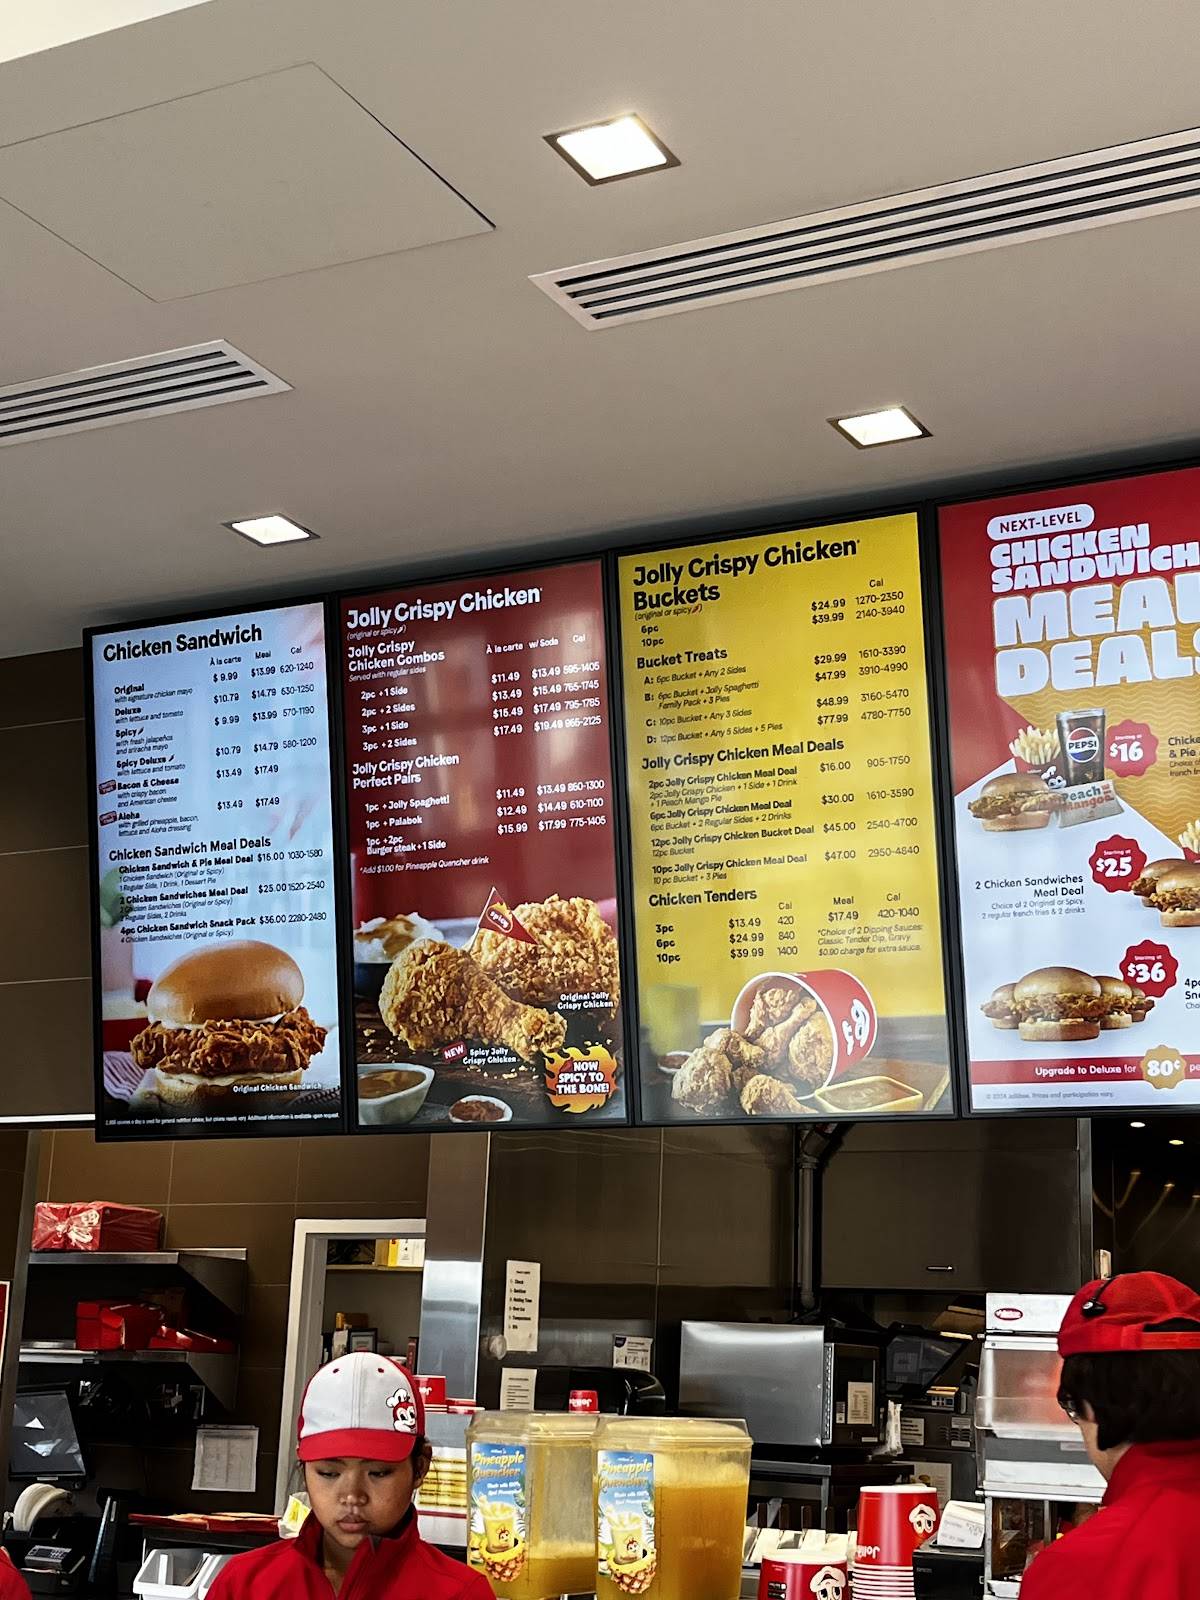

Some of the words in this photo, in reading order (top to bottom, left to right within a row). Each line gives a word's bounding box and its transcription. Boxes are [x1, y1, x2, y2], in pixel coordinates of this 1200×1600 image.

[1000, 511, 1081, 534] NEXT-LEVEL
[990, 523, 1150, 568] CHICKEN
[633, 564, 684, 587] Jolly
[688, 554, 758, 577] Crispy
[991, 542, 1200, 593] SANDWICH
[869, 579, 883, 588] Cal
[633, 584, 720, 611] Buckets
[811, 598, 846, 612] $24.99
[855, 591, 904, 605] 1270-2350
[346, 608, 391, 629] Jolly
[395, 599, 457, 622] Crispy
[811, 612, 844, 625] $39.99
[856, 605, 905, 619] 2140-3940
[641, 625, 658, 634] 6pc
[103, 640, 172, 662] Chicken
[176, 624, 262, 651] Sandwich
[348, 645, 375, 659] Jolly
[377, 640, 415, 655] Crispy
[540, 637, 558, 648] Soda
[641, 637, 664, 648] 10pc
[255, 651, 271, 659] Meal
[349, 658, 395, 671] Chicken
[397, 651, 445, 666] Combos
[637, 652, 682, 669] Bucket
[685, 648, 728, 663] Treats
[814, 653, 847, 665] $29.99
[996, 628, 1200, 697] DEAL
[114, 683, 145, 695] Original
[251, 666, 276, 677] $13.99
[280, 662, 314, 673] 620-1240
[491, 672, 520, 684] $11.49
[531, 667, 561, 679] $13.49
[644, 676, 654, 685] A:
[672, 671, 697, 682] Bucket
[704, 670, 718, 679] Any
[727, 665, 746, 675] Sides
[815, 670, 846, 682] $47.99
[859, 662, 908, 676] 3910-4990
[361, 690, 375, 700] 2pc
[390, 686, 408, 696] Side
[492, 689, 522, 701] $13.49
[115, 706, 141, 716] Deluxe
[214, 693, 239, 704] $10.79
[252, 688, 277, 699] $14.79
[533, 703, 561, 714] $17.49
[816, 696, 848, 708] $48.99
[129, 714, 149, 722] lettuce
[150, 712, 162, 720] and
[163, 710, 184, 719] tomato
[817, 714, 848, 726] $77.99
[861, 707, 911, 721] 4780-7750
[115, 729, 137, 738] Spicy
[494, 725, 523, 737] $17.49
[1068, 740, 1097, 750] PEPSI
[1168, 736, 1200, 746] Chicke
[641, 755, 671, 770] Jolly
[673, 752, 714, 767] Crispy
[717, 747, 769, 763] Chicken
[772, 743, 804, 756] Meal
[807, 738, 844, 752] Deals
[1110, 742, 1144, 762] $16
[353, 763, 378, 775] Jolly
[379, 759, 413, 775] Crispy
[416, 754, 459, 767] Chicken
[820, 761, 851, 773] $16.00
[118, 782, 141, 791] Bacon
[150, 777, 179, 786] Cheese
[353, 777, 392, 789] Perfect
[394, 773, 421, 786] Pairs
[649, 780, 664, 790] 2pc
[666, 777, 685, 788] Jolly
[687, 774, 715, 786] Crispy
[716, 770, 752, 782] Chicken
[754, 768, 776, 778] Meal
[778, 767, 797, 776] Deal
[496, 788, 525, 800] $11.49
[536, 784, 566, 796] $13.49
[821, 793, 854, 805] $30.00
[118, 811, 140, 821] Aloha
[217, 800, 243, 810] $13.49
[255, 797, 280, 807] $17.49
[497, 805, 527, 817] $12.49
[537, 802, 567, 814] $14.49
[570, 798, 604, 809] 610-1100
[498, 823, 528, 835] $15.99
[538, 820, 566, 832] $17.99
[823, 821, 856, 833] $45.00
[866, 817, 917, 829] 2540-4700
[109, 849, 152, 861] Chicken
[154, 844, 207, 858] Sandwich
[210, 839, 237, 852] Meal
[239, 836, 271, 849] Deals
[824, 850, 856, 861] $47.00
[405, 860, 437, 871] Pineapple
[439, 858, 470, 868] Quencher
[472, 856, 489, 865] drink
[1096, 857, 1132, 877] $25
[975, 881, 981, 889] 2
[984, 879, 1021, 889] Chicken
[1025, 874, 1083, 885] Sandwiches
[649, 892, 702, 907] Chicken
[704, 888, 757, 902] Tenders
[1034, 888, 1058, 898] Meal
[1061, 886, 1084, 896] Deal
[778, 901, 792, 910] Cal
[833, 896, 854, 905] Meal
[259, 914, 287, 924] $36.00
[828, 910, 859, 923] $17.49
[877, 907, 919, 918] 420-1040
[120, 926, 135, 936] 4pc
[137, 923, 168, 934] Chicken
[170, 920, 207, 931] Sandwich
[210, 918, 233, 928] Snack
[235, 917, 256, 926] Pack
[656, 924, 673, 934] 3pc
[729, 918, 761, 929] $13.49
[777, 916, 794, 925] 420
[656, 939, 675, 949] 6pc
[729, 932, 764, 945] $24.99
[657, 953, 680, 964] 10pc
[730, 948, 764, 960] $39.99
[1127, 962, 1166, 983] $36
[560, 993, 589, 1002] Original
[591, 992, 610, 1000] Jolly
[558, 1001, 581, 1010] Crispy
[583, 1000, 613, 1009] Chicken
[444, 1046, 465, 1059] NEW
[470, 1049, 489, 1057] Spicy
[491, 1048, 509, 1056] Jolly
[462, 1057, 485, 1065] Crispy
[487, 1056, 516, 1064] Chicken
[574, 1061, 598, 1071] NOW
[559, 1073, 586, 1083] SPICY
[588, 1072, 604, 1082] TO
[1035, 1066, 1075, 1076] Upgrade
[1078, 1066, 1087, 1074] to
[1089, 1064, 1121, 1074] Deluxe
[1124, 1064, 1136, 1073] for
[233, 1085, 259, 1094] Original
[261, 1084, 287, 1092] Chicken
[289, 1083, 322, 1091] Sandwich
[557, 1085, 577, 1094] THE
[579, 1084, 609, 1093] BONE!
[472, 1451, 524, 1468] Pineapple
[472, 1467, 520, 1481] Quencher
[599, 1461, 652, 1476] Pineapple
